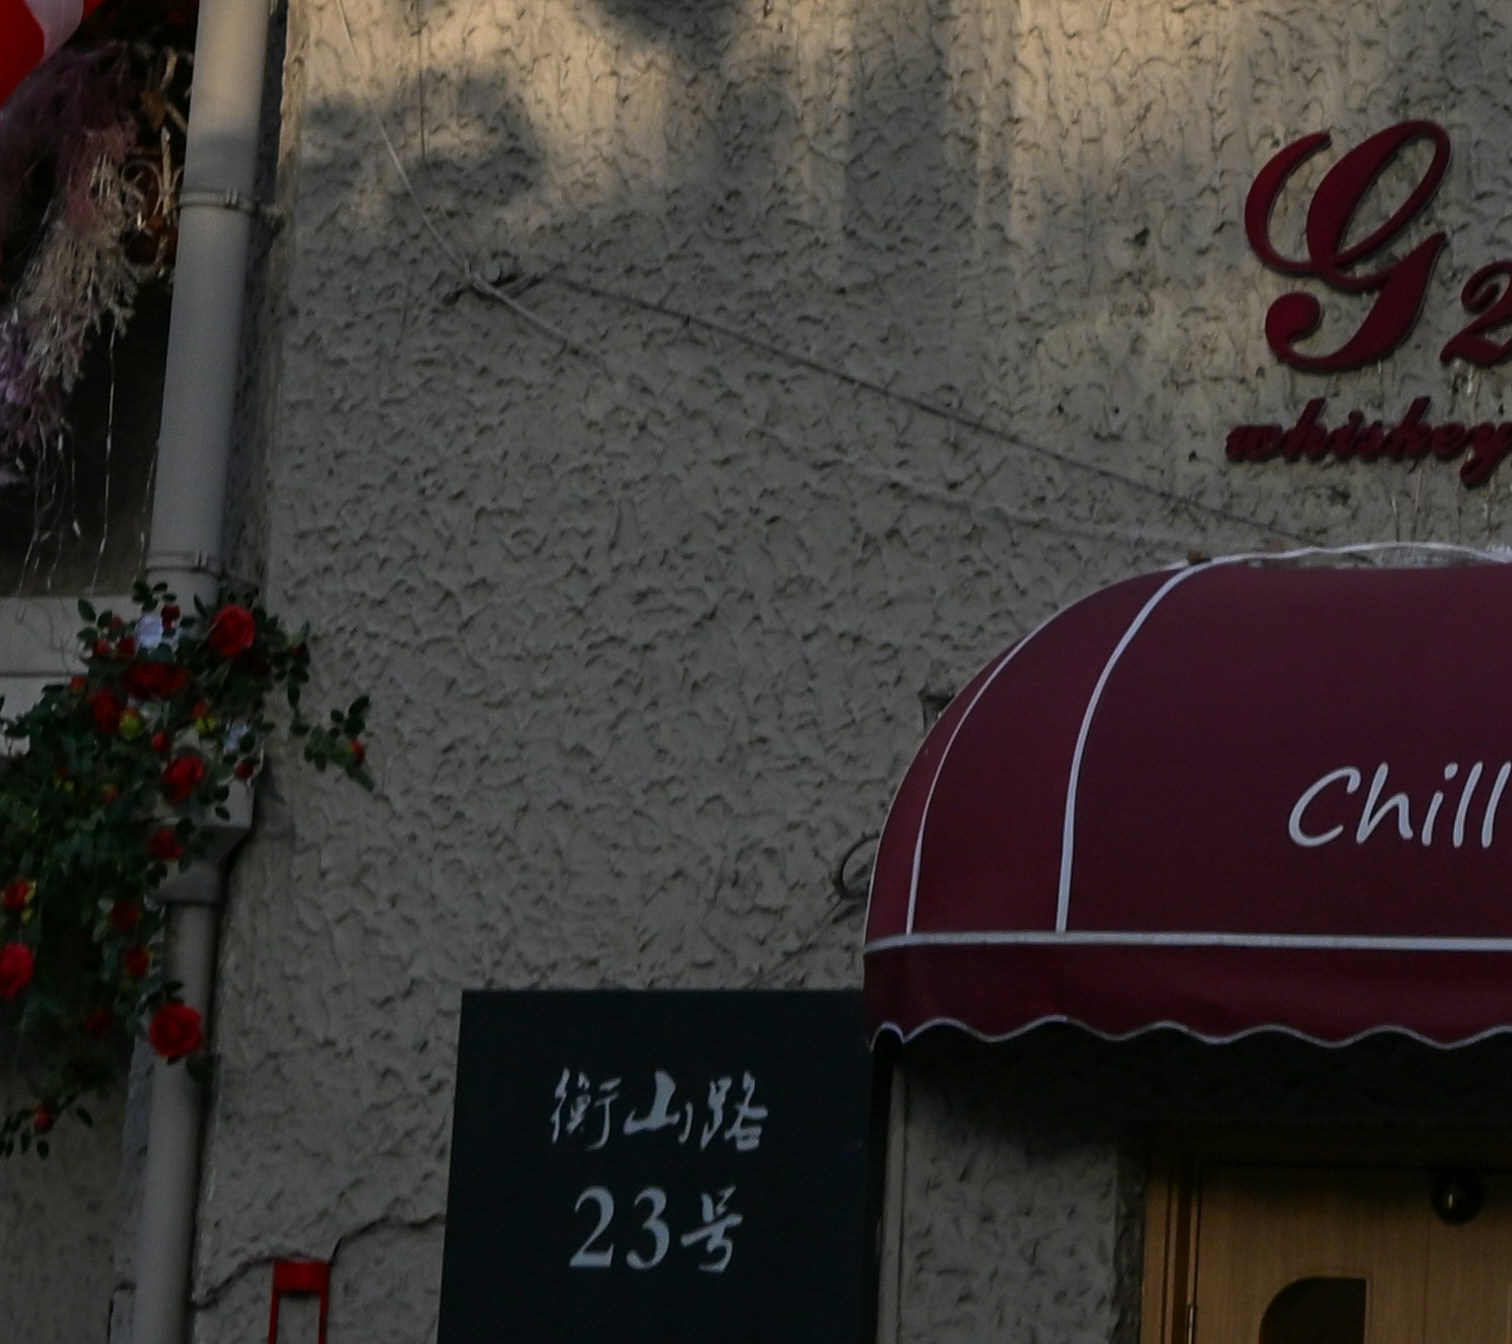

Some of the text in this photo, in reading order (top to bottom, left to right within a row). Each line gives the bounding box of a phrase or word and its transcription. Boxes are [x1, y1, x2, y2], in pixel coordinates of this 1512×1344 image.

[1287, 761, 1512, 850] Chill
[549, 1067, 770, 1152] 衡山路
[568, 1184, 744, 1273] 23号
